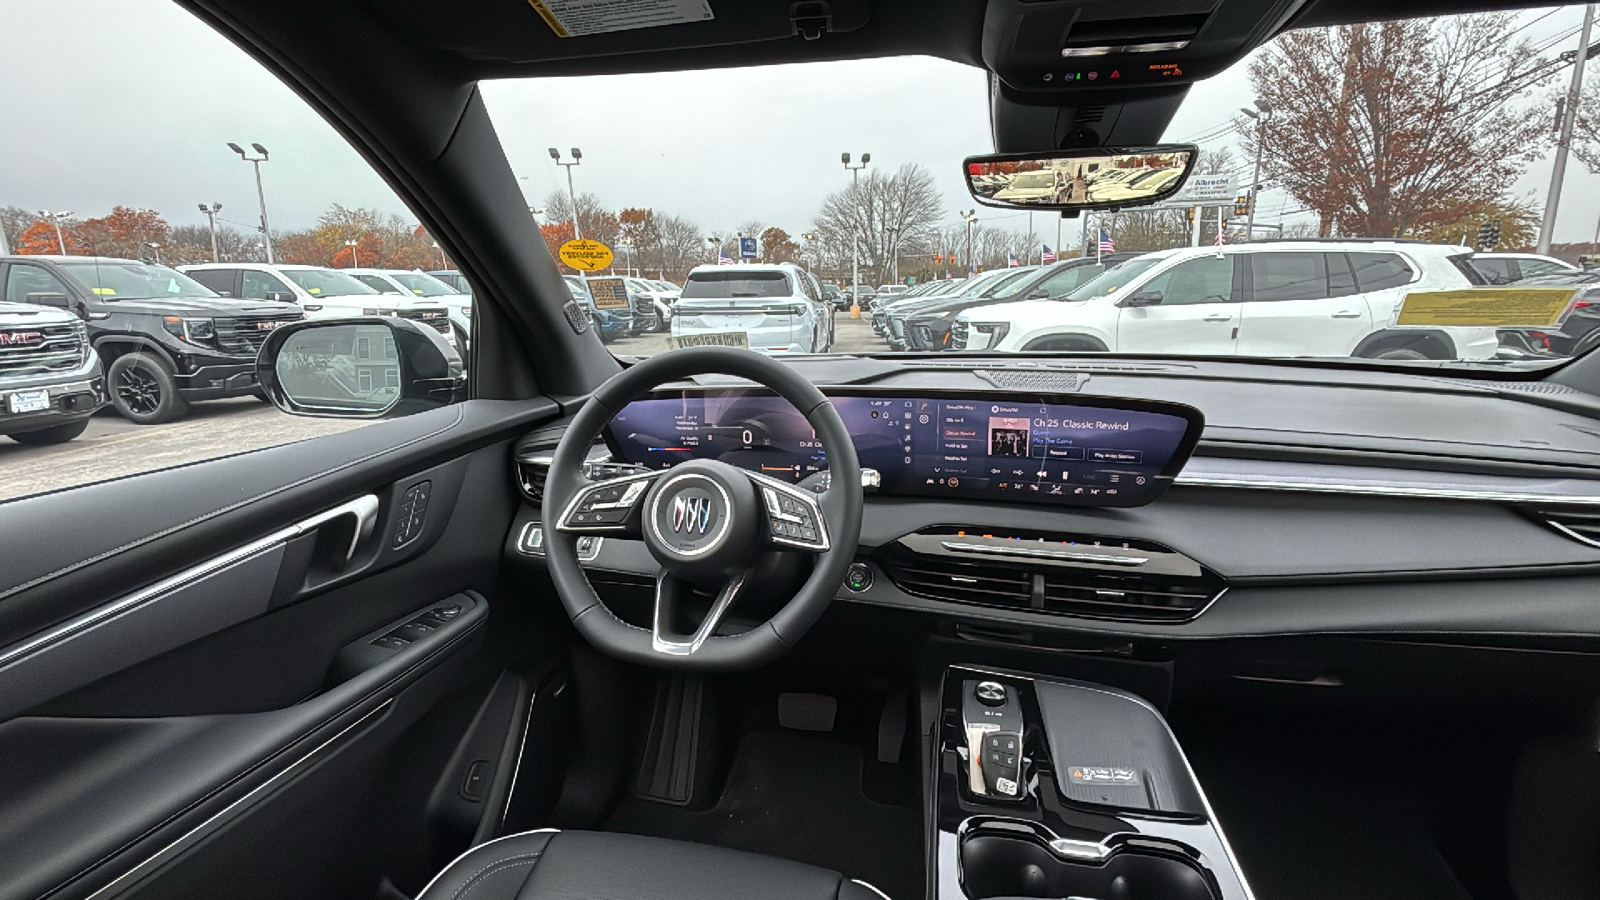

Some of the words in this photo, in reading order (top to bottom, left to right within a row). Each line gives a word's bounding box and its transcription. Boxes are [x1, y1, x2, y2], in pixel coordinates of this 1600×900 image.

[1034, 418, 1045, 428] Ch
[1047, 420, 1059, 428] 25
[1063, 420, 1093, 429] Classic
[1096, 421, 1129, 430] Rewind
[743, 430, 752, 444] 0
